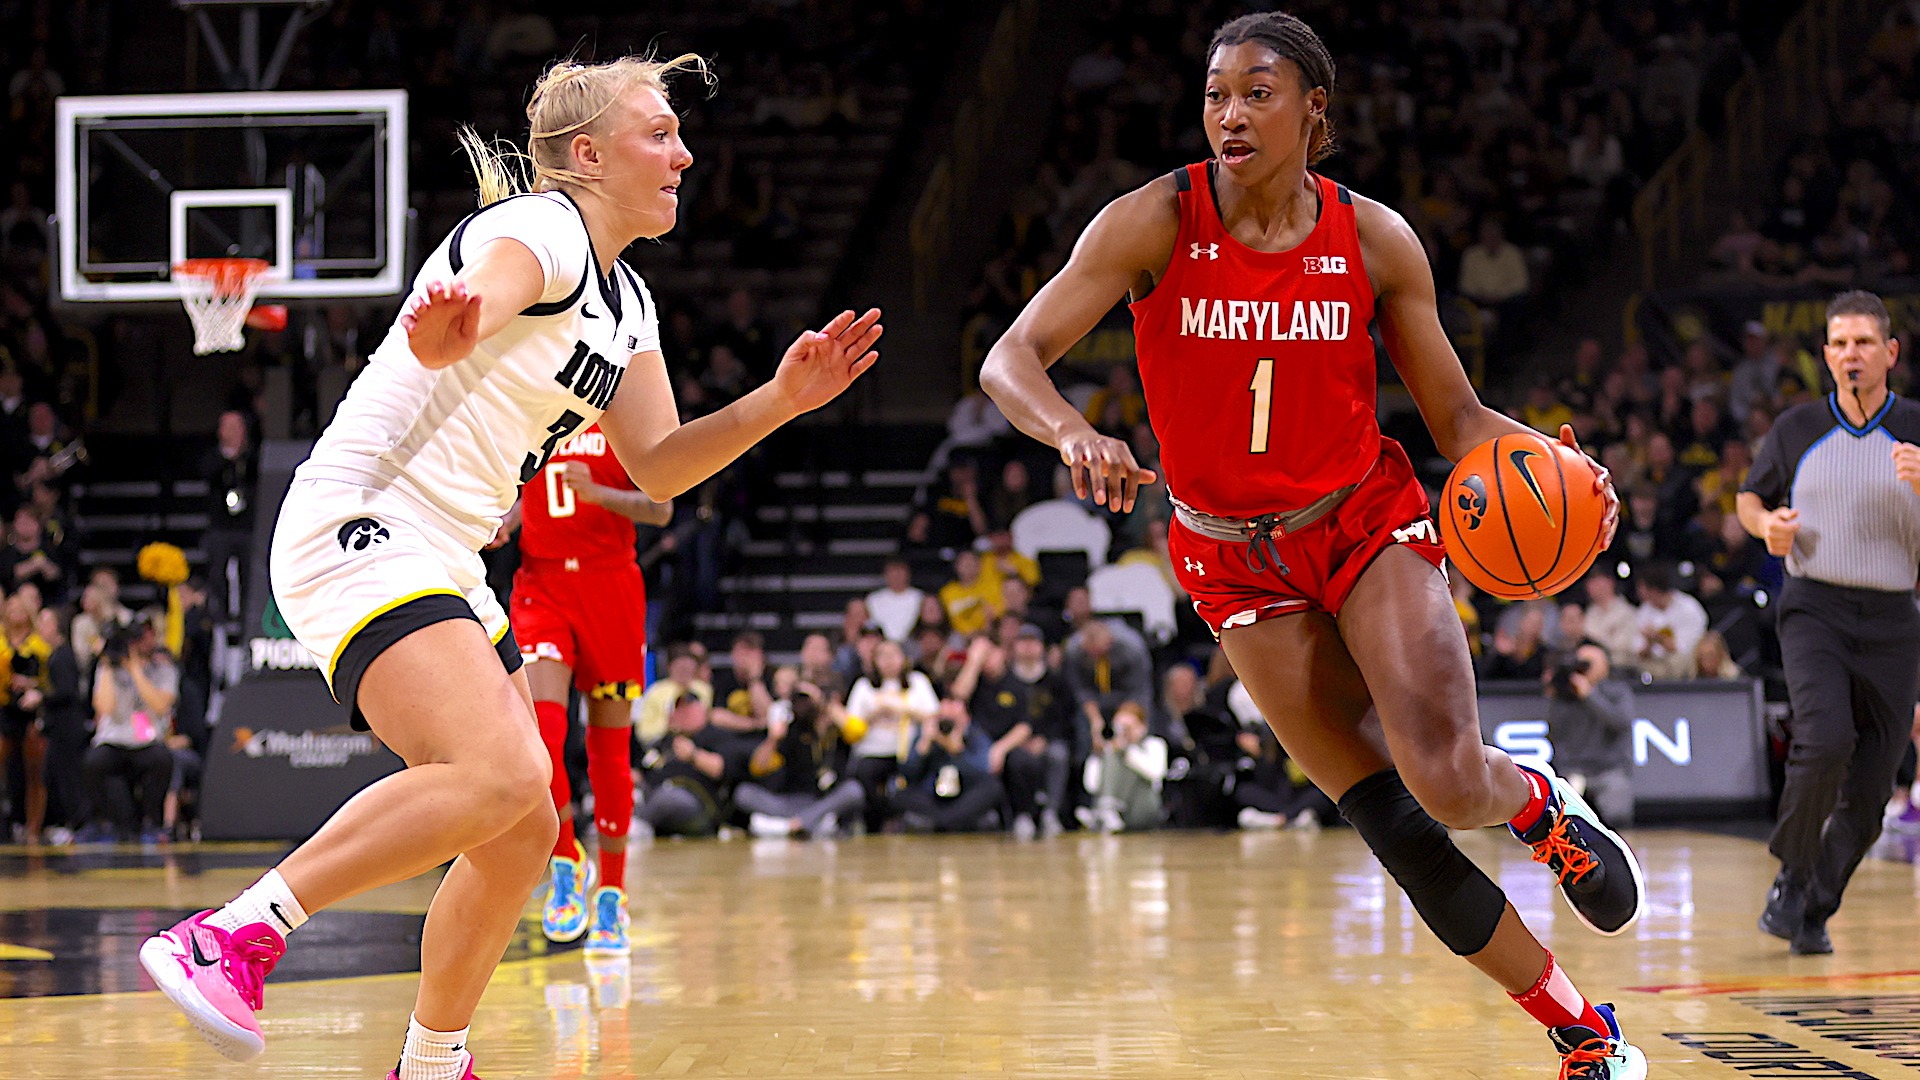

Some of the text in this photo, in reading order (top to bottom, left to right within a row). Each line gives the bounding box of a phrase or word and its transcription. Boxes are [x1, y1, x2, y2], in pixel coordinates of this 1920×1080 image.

[1180, 297, 1350, 341] MARYLAND
[1249, 358, 1274, 454] 1
[519, 408, 585, 483] 3
[555, 432, 606, 457] LAND
[545, 462, 576, 518] 0
